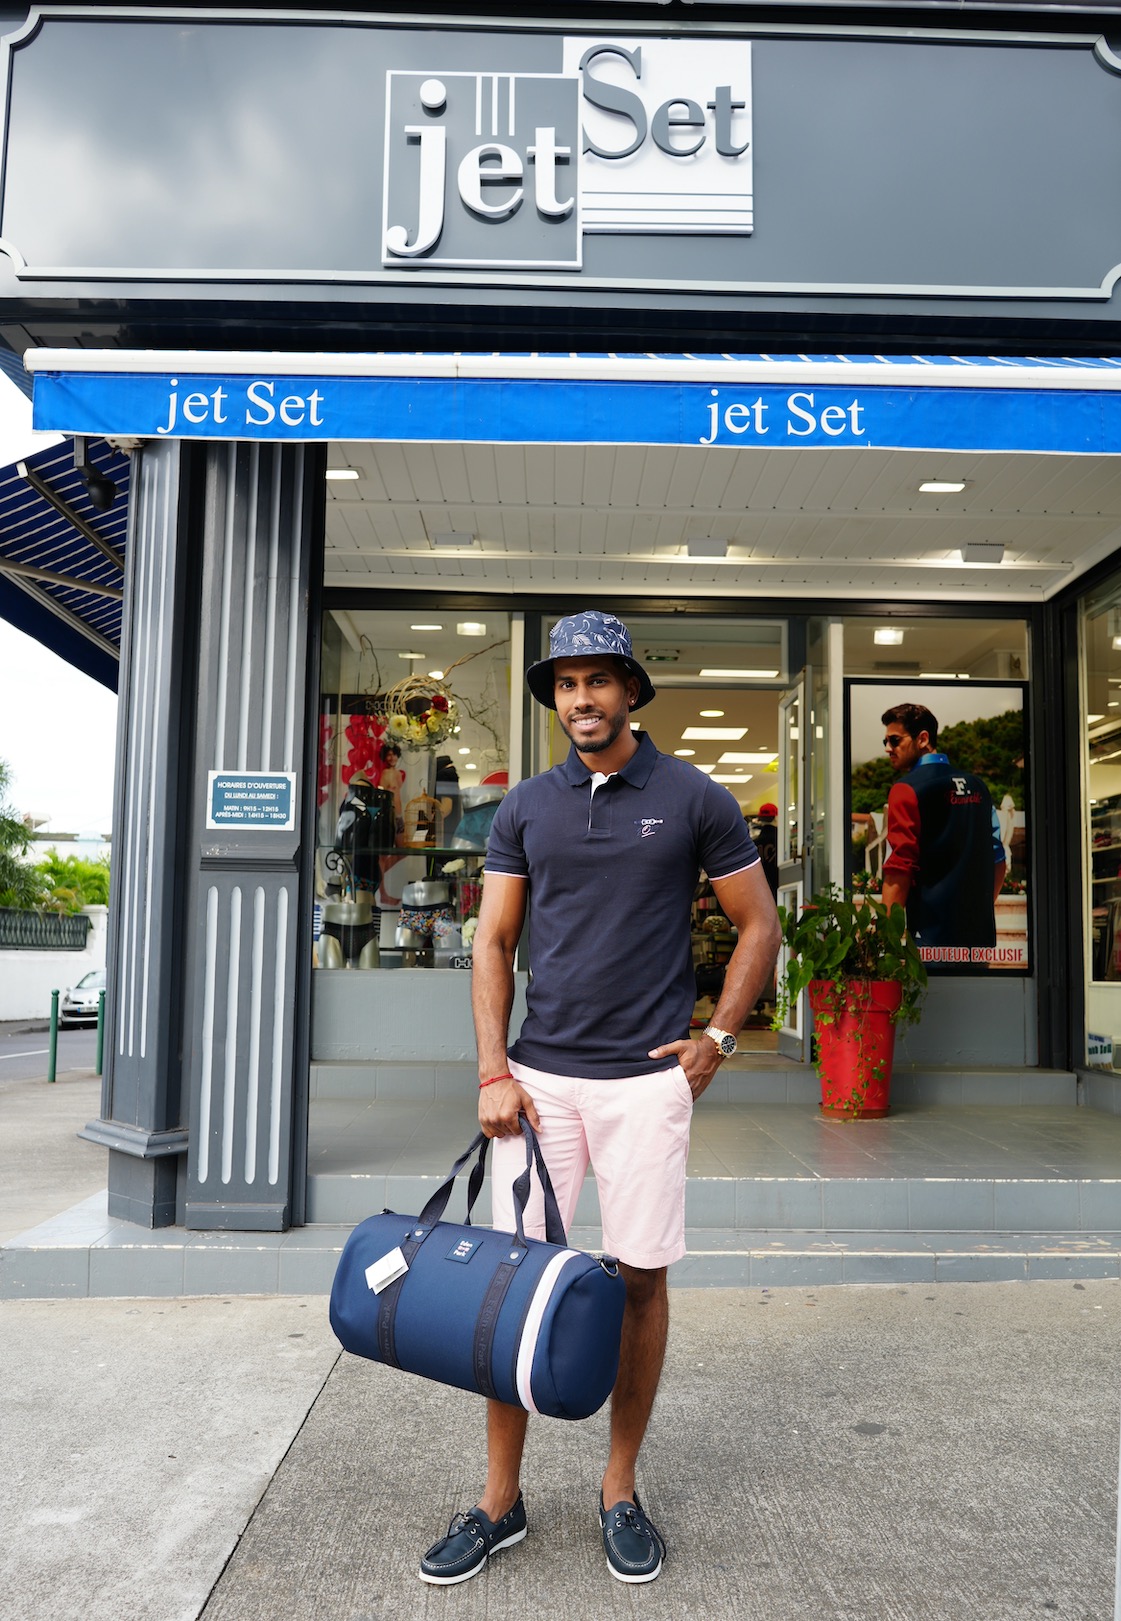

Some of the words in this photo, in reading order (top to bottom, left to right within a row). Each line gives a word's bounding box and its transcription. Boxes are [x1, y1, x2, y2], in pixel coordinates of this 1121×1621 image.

[387, 79, 574, 255] jet
[579, 43, 750, 160] Set
[156, 378, 228, 434] jet
[245, 380, 325, 427] Set
[699, 388, 769, 444] jet
[787, 392, 866, 436] Set
[217, 781, 246, 789] HORAIRES
[247, 782, 287, 790] D'OUVERTURE
[971, 948, 1024, 961] EXCLUSIF
